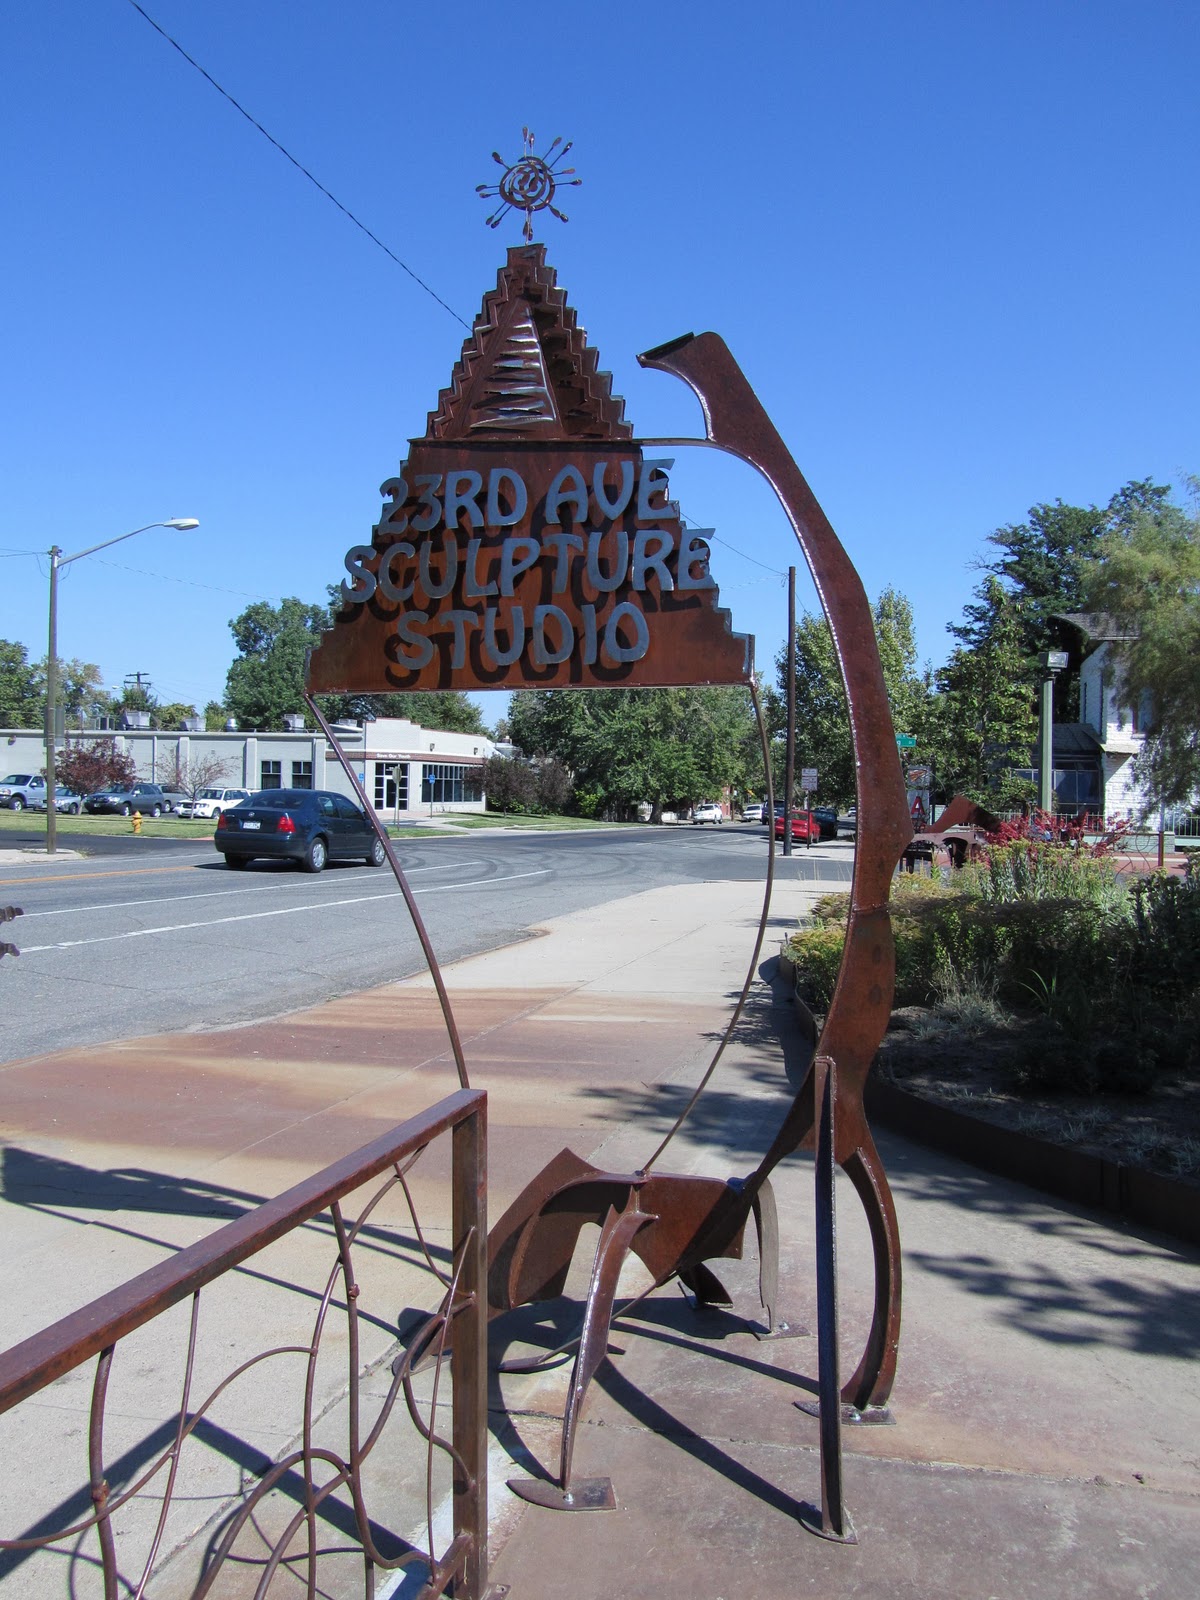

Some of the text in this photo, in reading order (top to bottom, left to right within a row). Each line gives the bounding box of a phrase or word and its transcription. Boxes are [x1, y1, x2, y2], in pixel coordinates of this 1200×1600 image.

[378, 458, 677, 535] 23RD AVE
[340, 527, 718, 603] SCULPTURE
[396, 601, 650, 670] STUDIO
